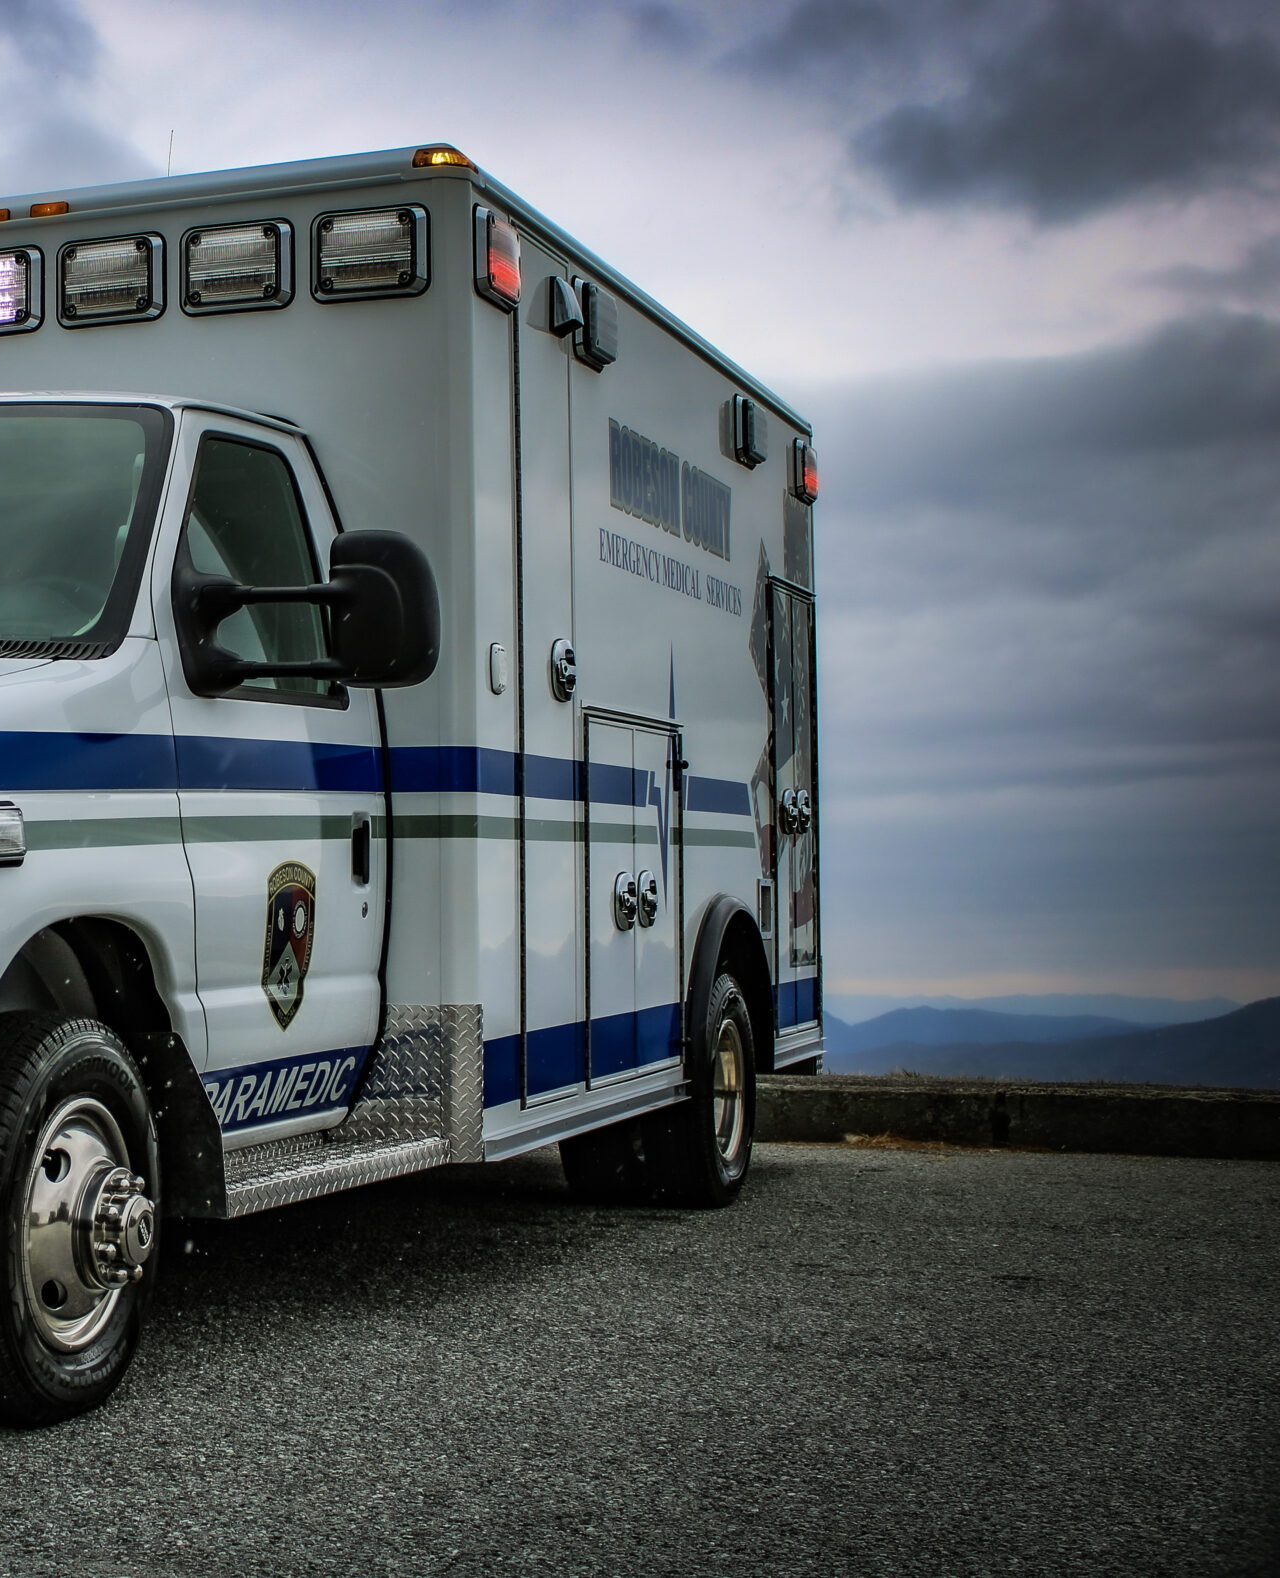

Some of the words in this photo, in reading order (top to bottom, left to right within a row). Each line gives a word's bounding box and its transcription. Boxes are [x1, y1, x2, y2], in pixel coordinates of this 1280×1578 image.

[608, 416, 681, 538] ROBESON
[681, 460, 732, 562] COUNTY
[599, 527, 661, 583] EMERGENCY
[662, 554, 701, 600] MEDICAL
[706, 574, 742, 617] SERVICES
[268, 867, 293, 896] ROBESON
[293, 867, 315, 892] COUNTY
